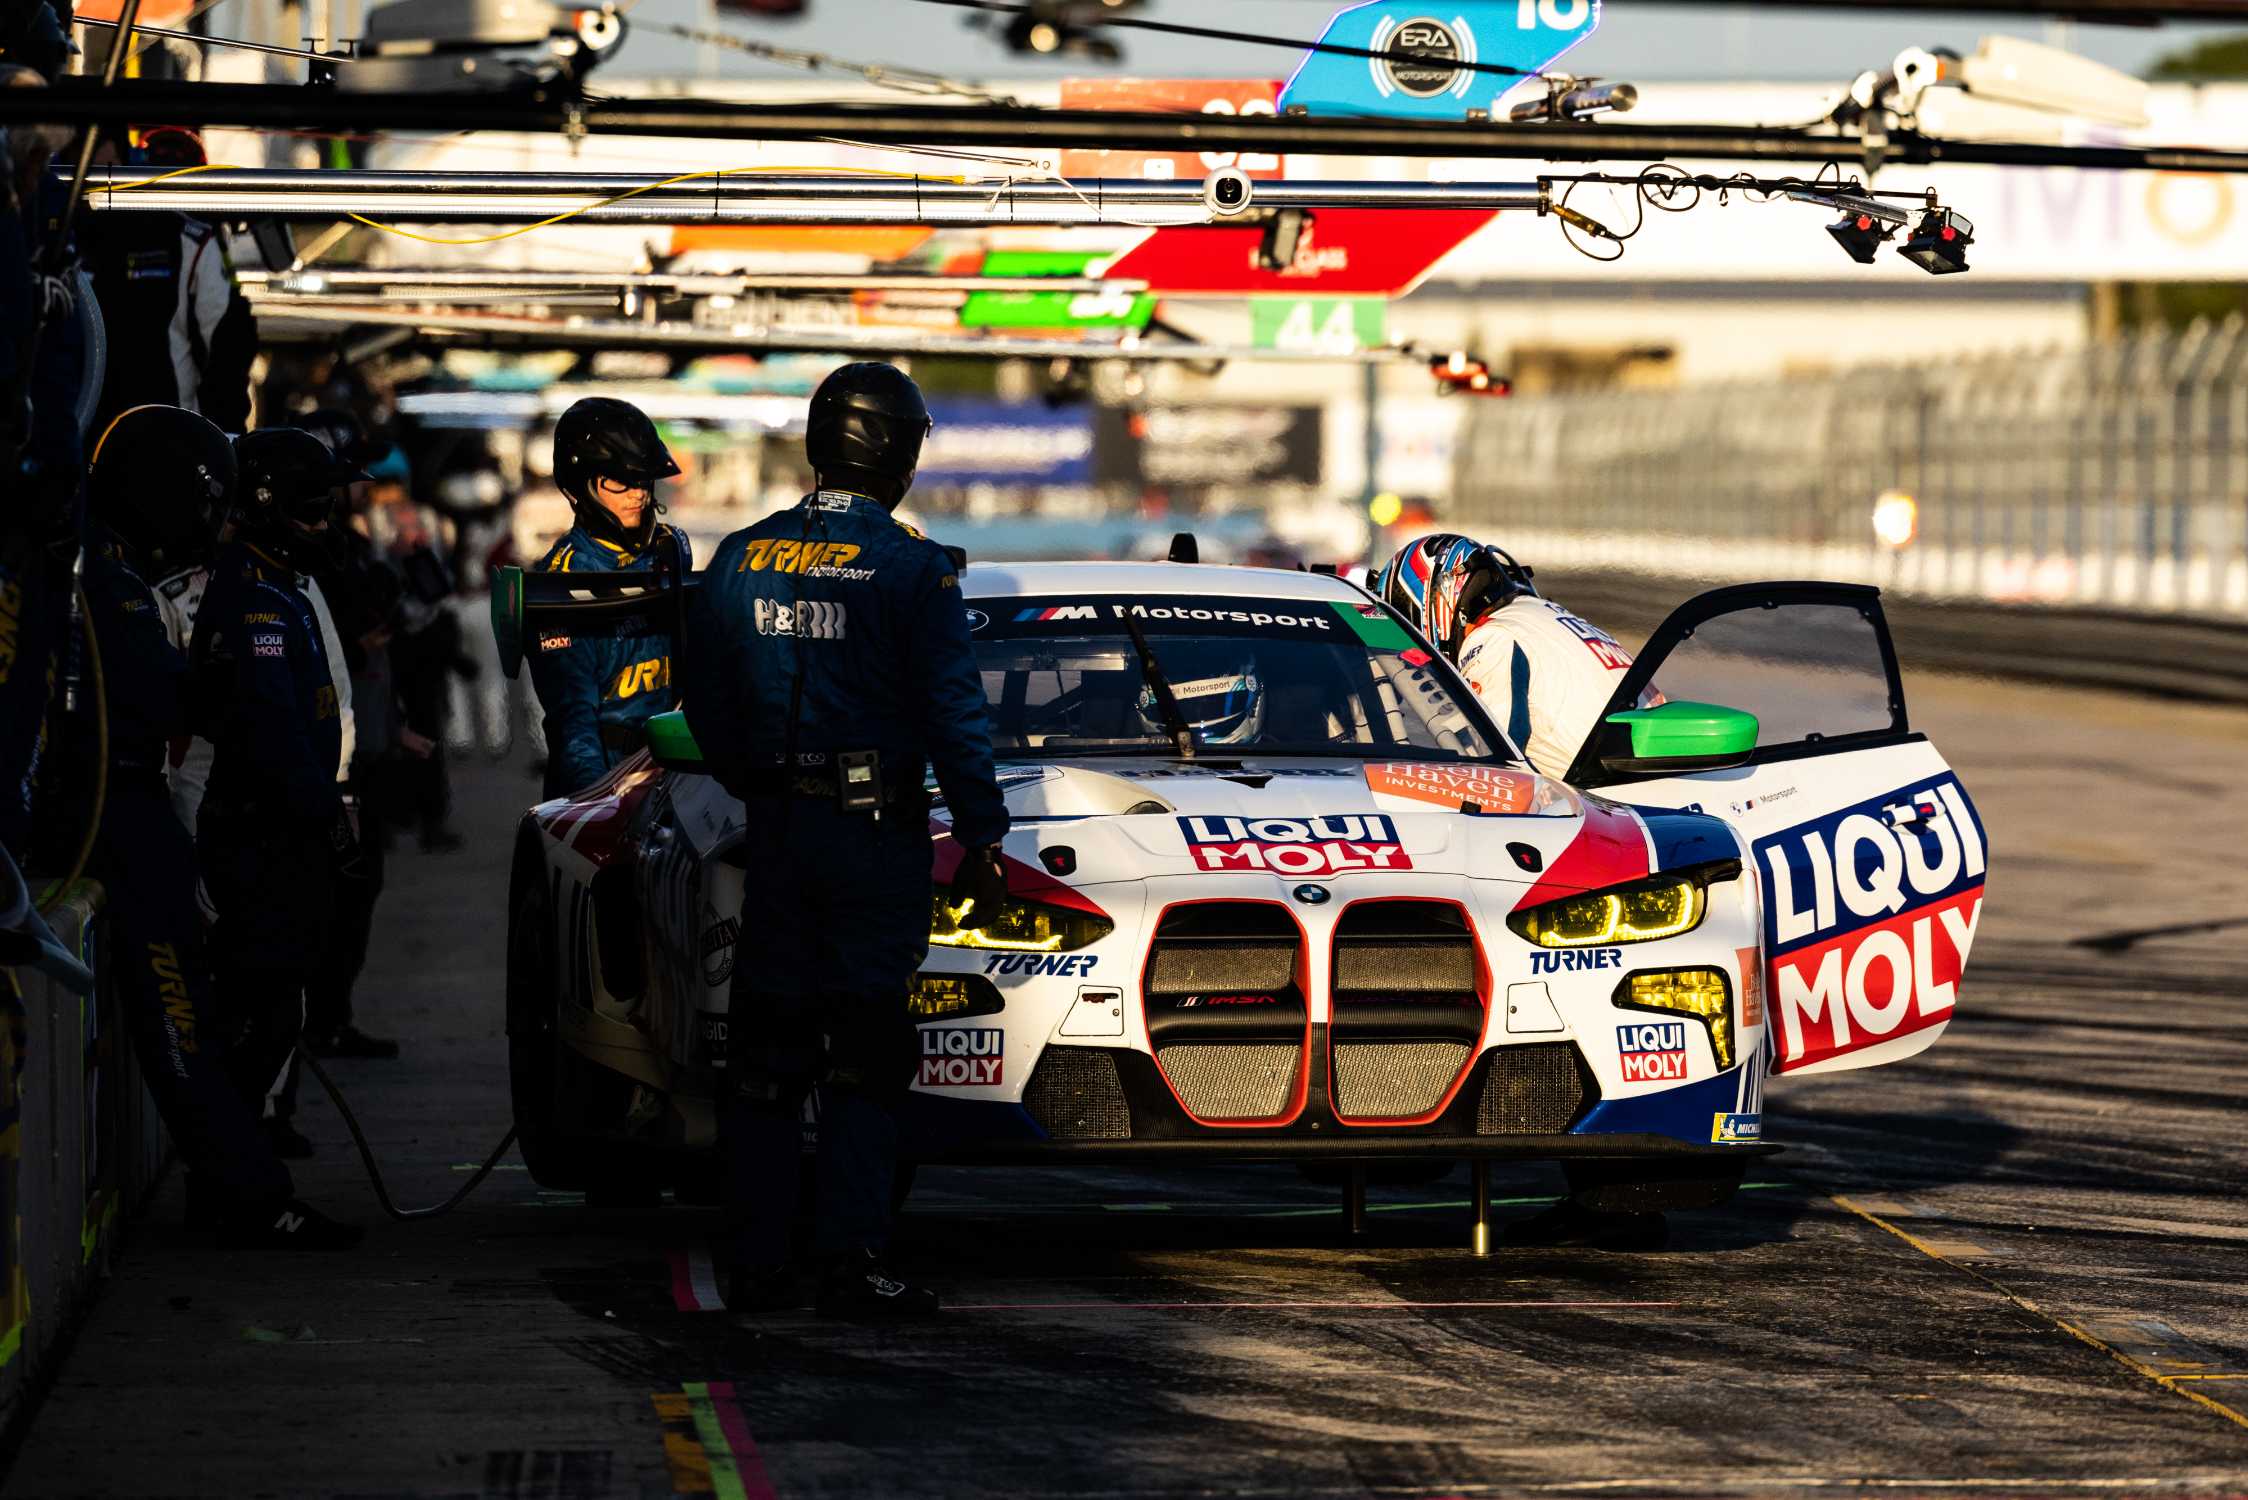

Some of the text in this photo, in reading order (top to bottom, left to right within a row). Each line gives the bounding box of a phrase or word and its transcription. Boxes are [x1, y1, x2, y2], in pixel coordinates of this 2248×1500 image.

[1401, 29, 1450, 47] ERA
[1395, 71, 1453, 81] MOTORSPORT
[1275, 300, 1358, 355] 44
[737, 538, 861, 575] TURNER
[804, 565, 876, 581] motorsport
[1112, 605, 1330, 630] Motorsport
[253, 634, 284, 646] LIQUI
[254, 646, 285, 657] MOLY
[540, 636, 572, 651] MOLY
[1183, 681, 1230, 694] Motorsport
[1386, 777, 1512, 811] INVESTMENTS
[1760, 786, 1798, 803] Motorsport
[1188, 815, 1388, 844] LIQUI
[1201, 841, 1400, 873] MOLY
[1765, 782, 1985, 944] LIQUI
[983, 953, 1099, 978] TURNER
[1530, 948, 1622, 975] TURNER
[1777, 897, 1983, 1063] MOLY
[922, 1030, 1000, 1056] LIQUI
[1619, 1024, 1683, 1052] LIQUI
[922, 1058, 1001, 1085] MOLY
[1623, 1052, 1686, 1080] MOLY
